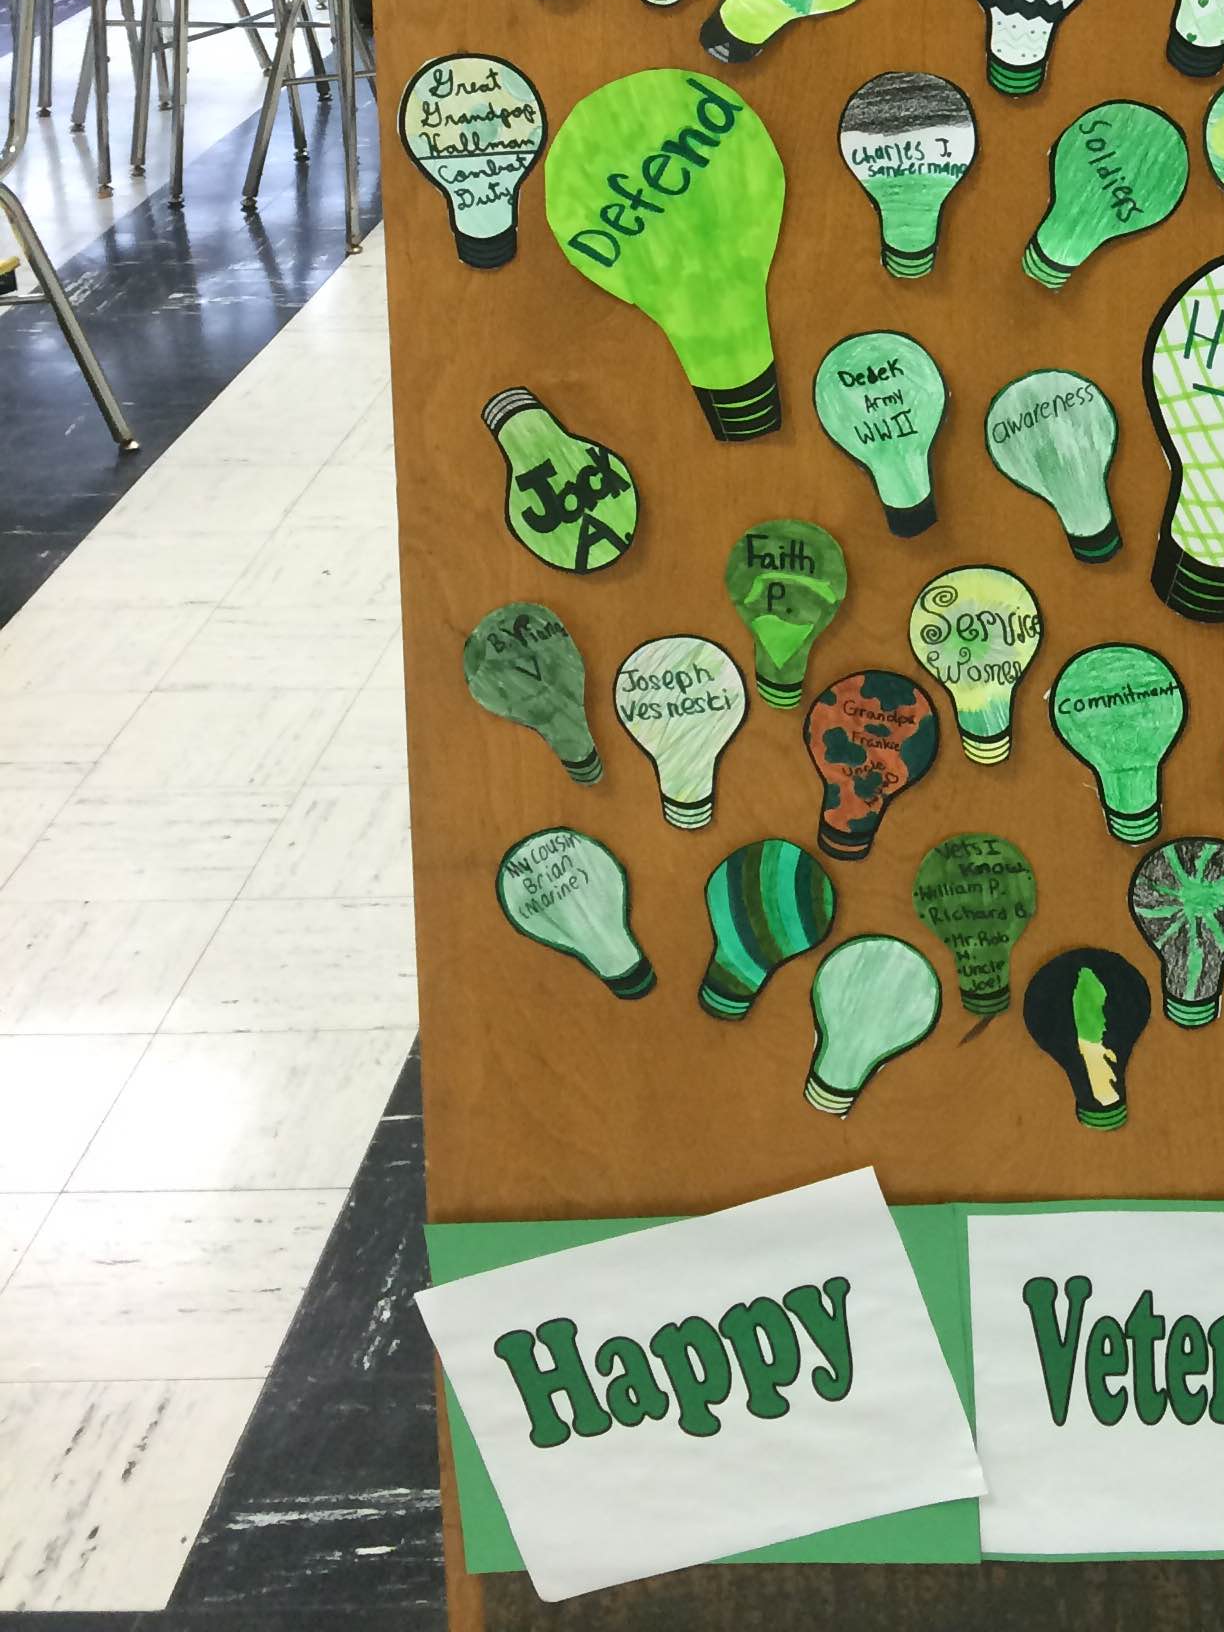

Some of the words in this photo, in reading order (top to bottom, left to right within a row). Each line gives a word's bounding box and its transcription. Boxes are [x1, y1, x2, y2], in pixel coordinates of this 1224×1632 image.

[428, 67, 502, 100] Great
[437, 155, 528, 185] Combat
[567, 76, 746, 269] Defend
[455, 183, 516, 211] Duty
[746, 533, 816, 576] Faith
[767, 582, 793, 615] P.
[618, 662, 715, 694] Joseph
[522, 854, 574, 895] Brian
[493, 1276, 854, 1448] Happy
